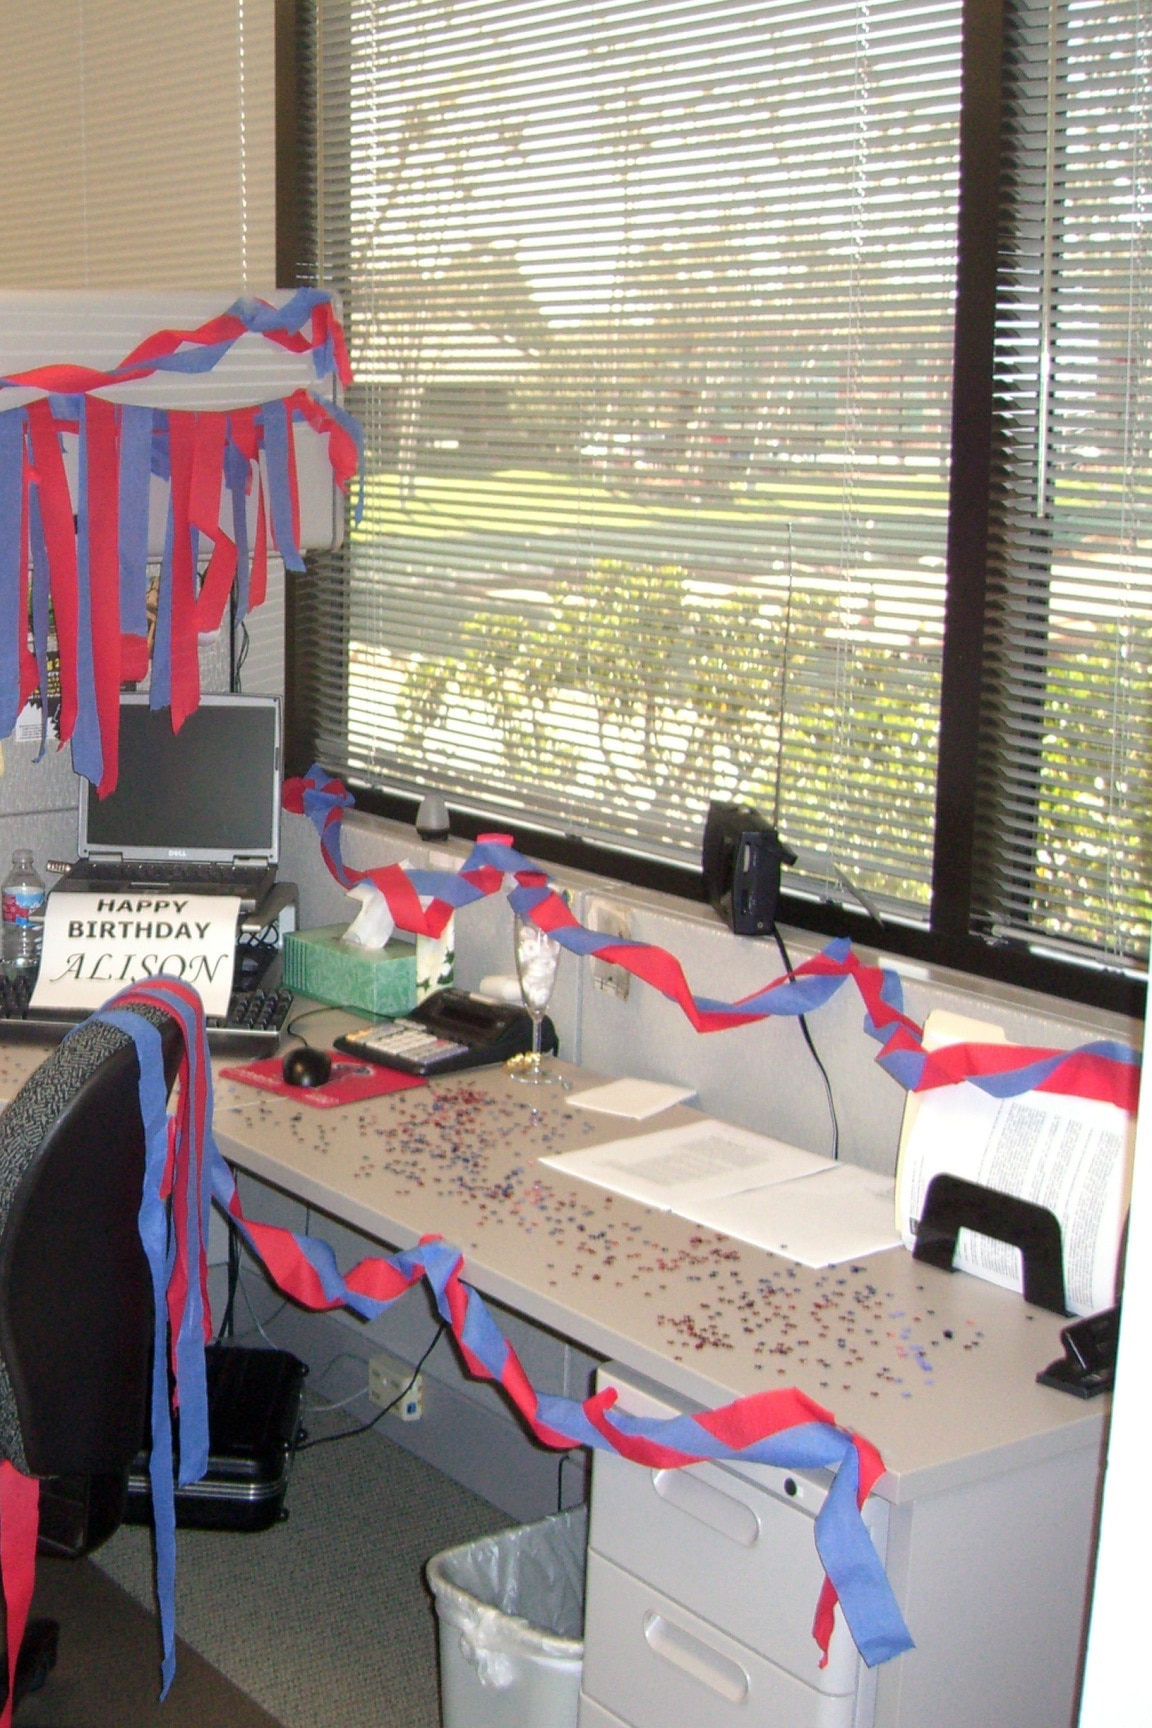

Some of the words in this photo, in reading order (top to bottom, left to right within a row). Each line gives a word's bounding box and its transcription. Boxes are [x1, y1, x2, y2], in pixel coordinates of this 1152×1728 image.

[97, 898, 189, 914] HAPPY
[67, 920, 212, 940] BIRTHDAY
[49, 952, 230, 984] ALISON
